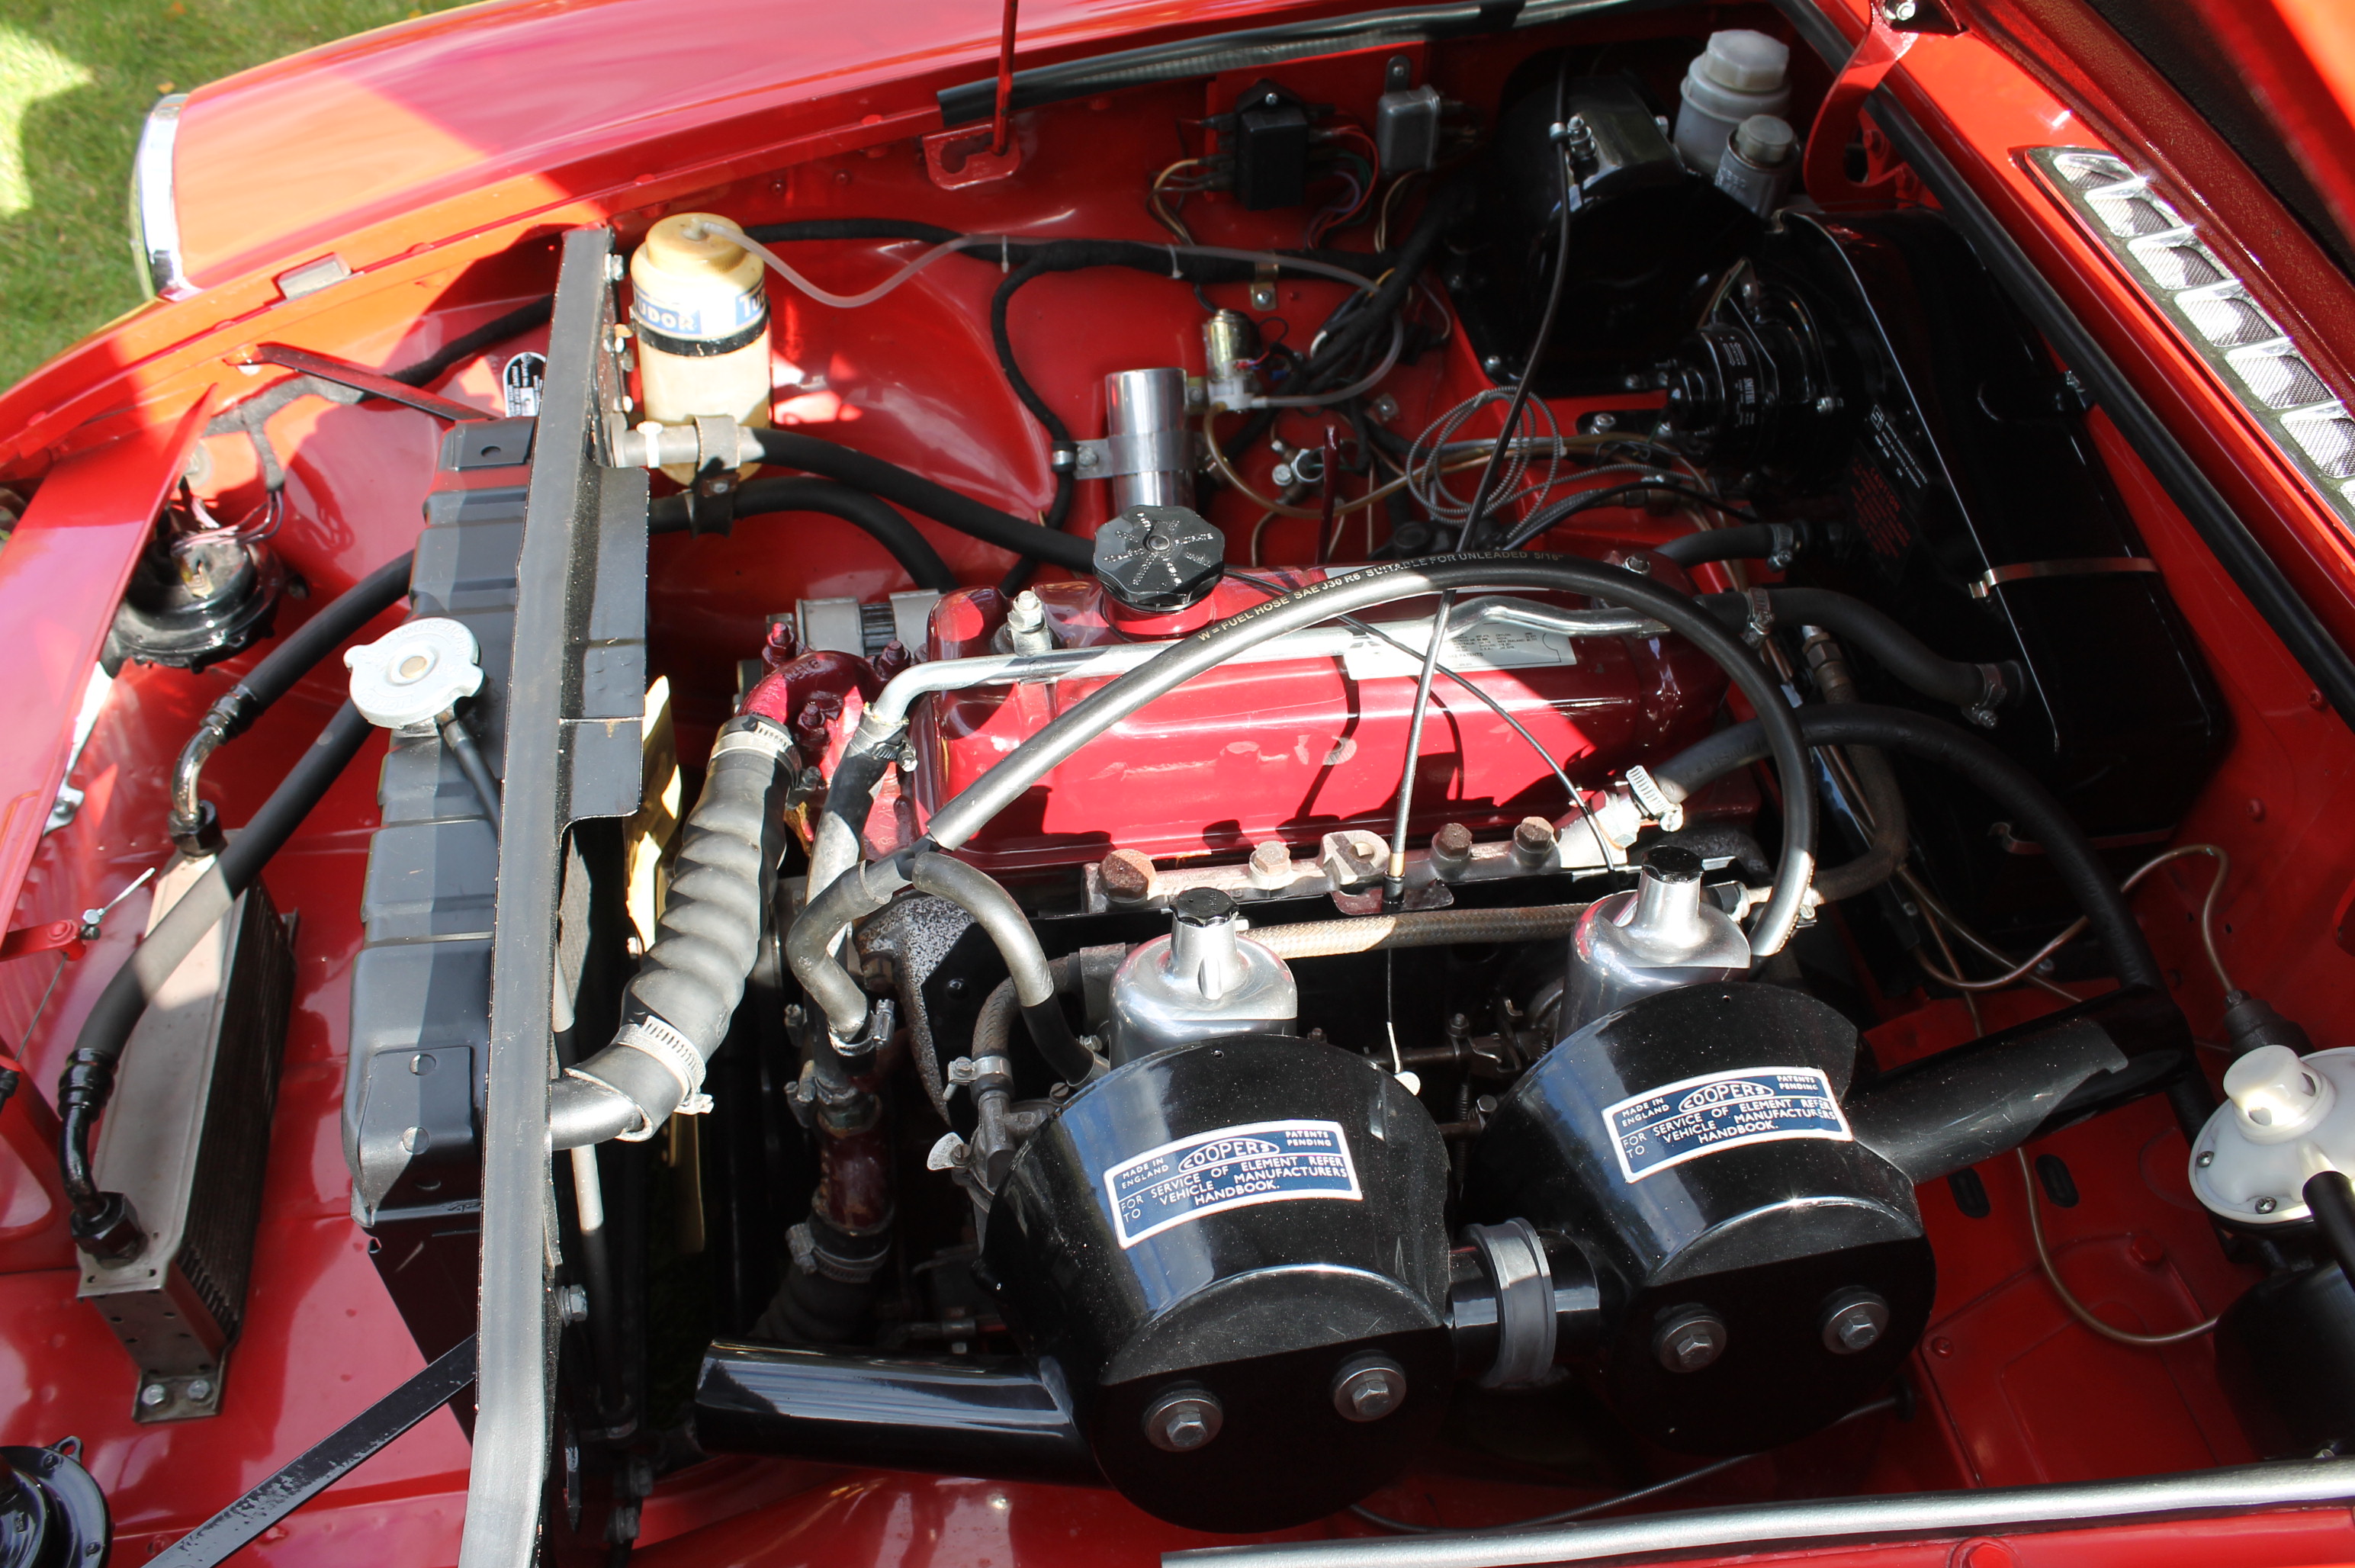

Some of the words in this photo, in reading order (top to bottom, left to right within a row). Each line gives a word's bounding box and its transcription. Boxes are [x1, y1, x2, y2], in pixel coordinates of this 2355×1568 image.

[638, 298, 695, 331] UDOR
[1220, 609, 1254, 631] FUEL
[1254, 596, 1290, 615] HOSE
[1294, 584, 1320, 600] SAE
[1322, 577, 1342, 591] J30
[1345, 572, 1361, 584] R6
[1365, 558, 1428, 577] SUITABLE
[1430, 554, 1457, 564] FOR
[1458, 551, 1528, 561] UNLEADED
[1622, 1103, 1650, 1118] MADE
[1651, 1097, 1664, 1106] IN
[1622, 1104, 1670, 1127] ENGLAND
[1285, 1130, 1329, 1139] PATENTS
[1622, 1133, 1647, 1149] FOR
[1653, 1113, 1703, 1136] SERVICE
[1711, 1107, 1730, 1119] OF
[1739, 1099, 1792, 1113] ELEMENT
[1801, 1099, 1833, 1111] REFER
[1626, 1145, 1645, 1158] TO
[1663, 1121, 1717, 1144] VEHICLE
[1733, 1107, 1837, 1125] MANUFACTURERS
[1698, 1123, 1779, 1145] HANDBOOK.
[1287, 1139, 1332, 1148] PENDING
[1121, 1164, 1170, 1190] ENGLAND
[1123, 1162, 1149, 1179] MADE
[1151, 1157, 1165, 1168] IN
[1120, 1194, 1145, 1212] FOR
[1150, 1174, 1202, 1200] SERVICE
[1210, 1165, 1229, 1179] OF
[1240, 1156, 1298, 1172] ELEMENT
[1309, 1156, 1344, 1168] REFER
[1123, 1209, 1142, 1223] TO
[1159, 1181, 1215, 1206] VEHICLE
[1233, 1167, 1348, 1185] MANUFACTURERS
[1194, 1180, 1280, 1207] HANDBOOK.
